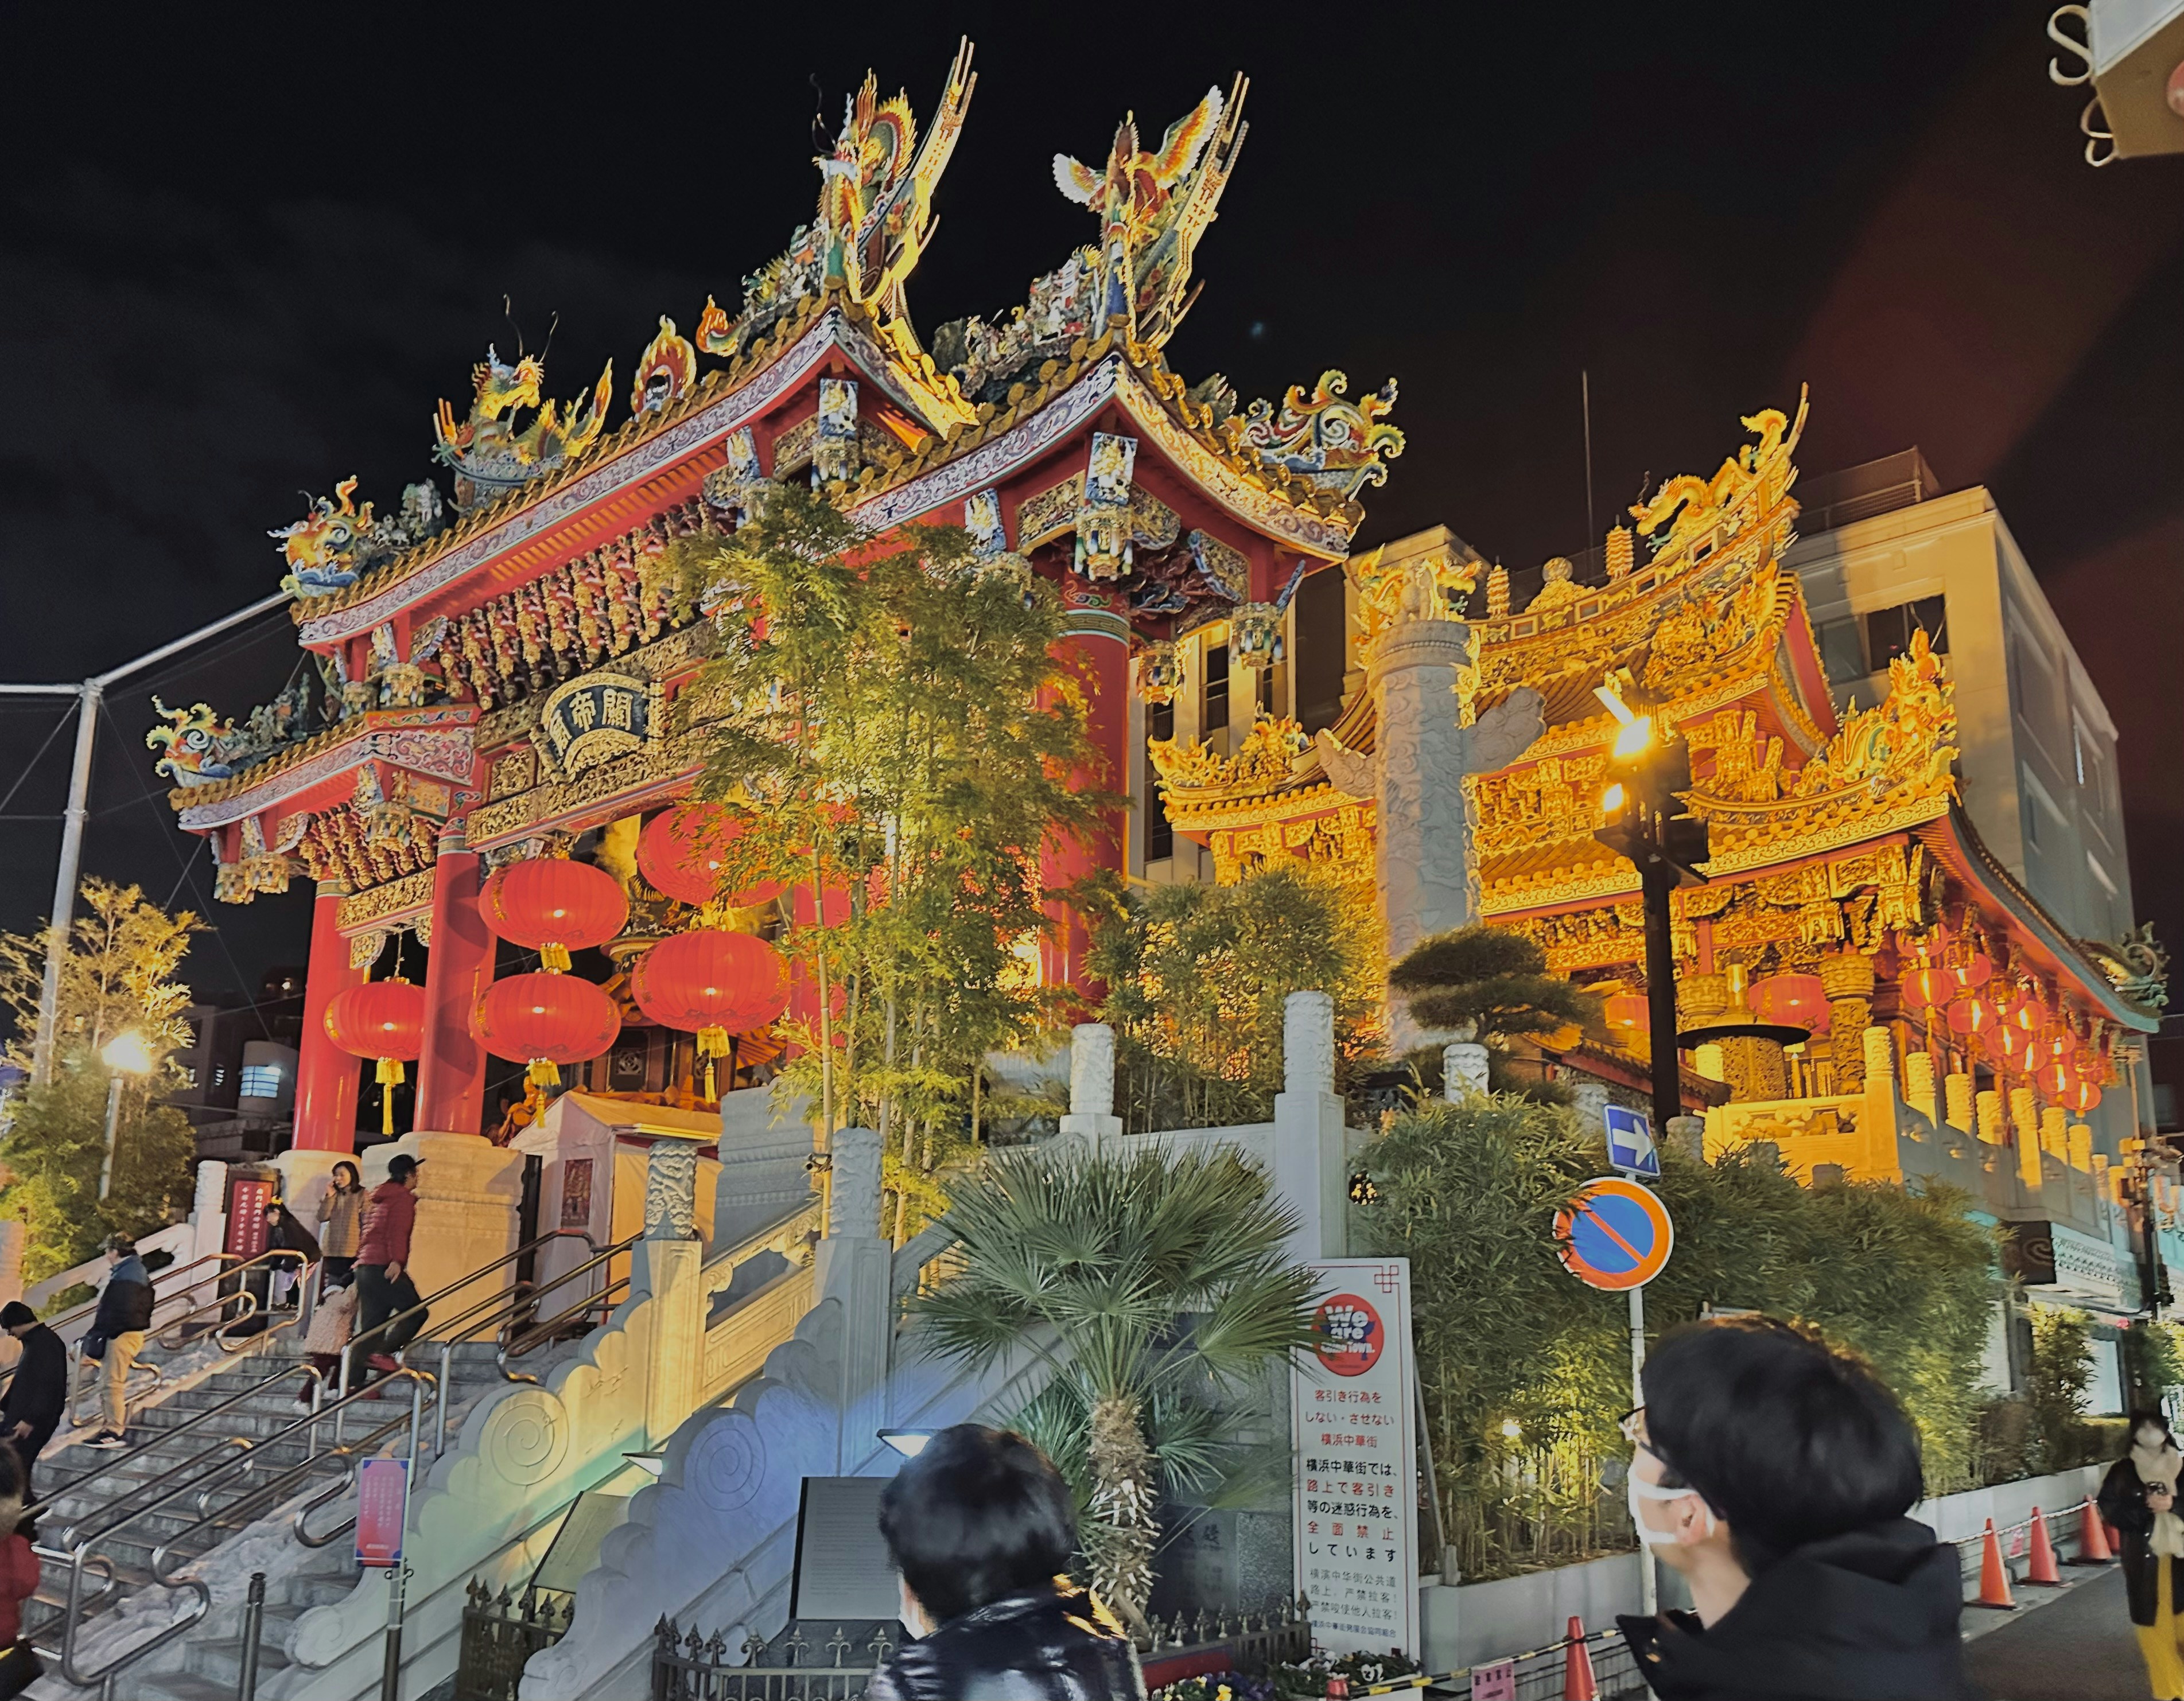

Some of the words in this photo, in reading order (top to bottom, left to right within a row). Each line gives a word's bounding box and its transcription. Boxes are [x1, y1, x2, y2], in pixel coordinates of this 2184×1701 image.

[1324, 1305, 1369, 1328] We
[1330, 1326, 1365, 1340] are
[1315, 1389, 1382, 1403] 客引き行為を
[1305, 1411, 1394, 1426] しない・させない
[1321, 1432, 1378, 1448] 横浜中華街
[1307, 1521, 1395, 1541] 全面禁止
[1309, 1542, 1397, 1562] しています
